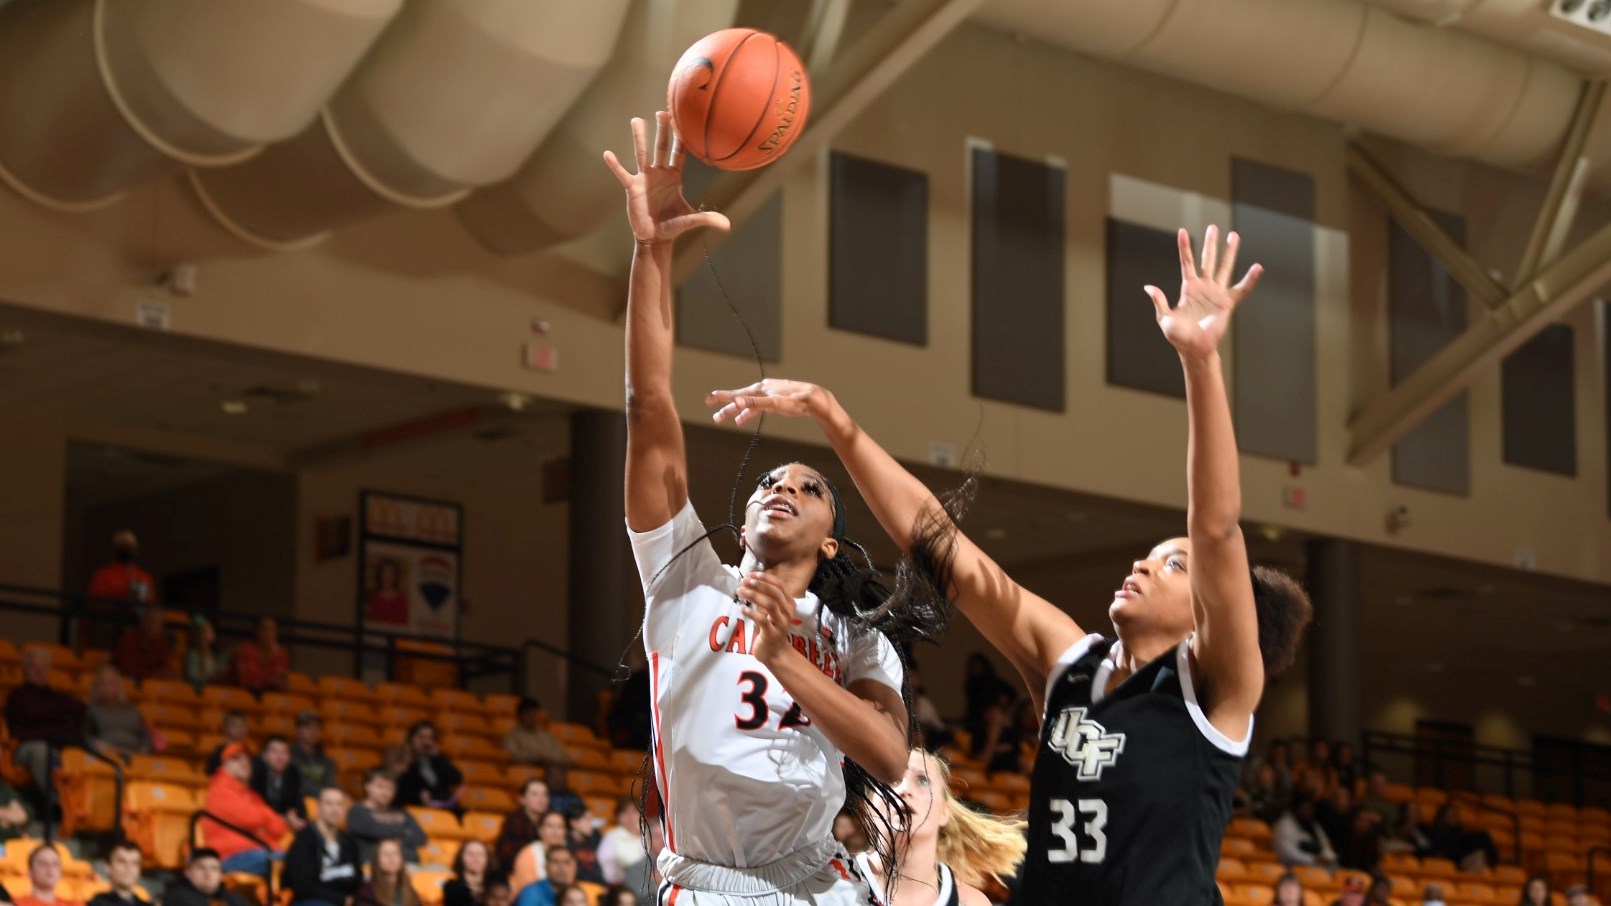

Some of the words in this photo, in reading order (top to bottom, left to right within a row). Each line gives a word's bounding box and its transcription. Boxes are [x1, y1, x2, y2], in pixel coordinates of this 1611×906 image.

[757, 71, 801, 154] SPALDING
[708, 615, 843, 687] CABELL
[1048, 707, 1127, 781] UCF
[1048, 799, 1108, 864] 33
